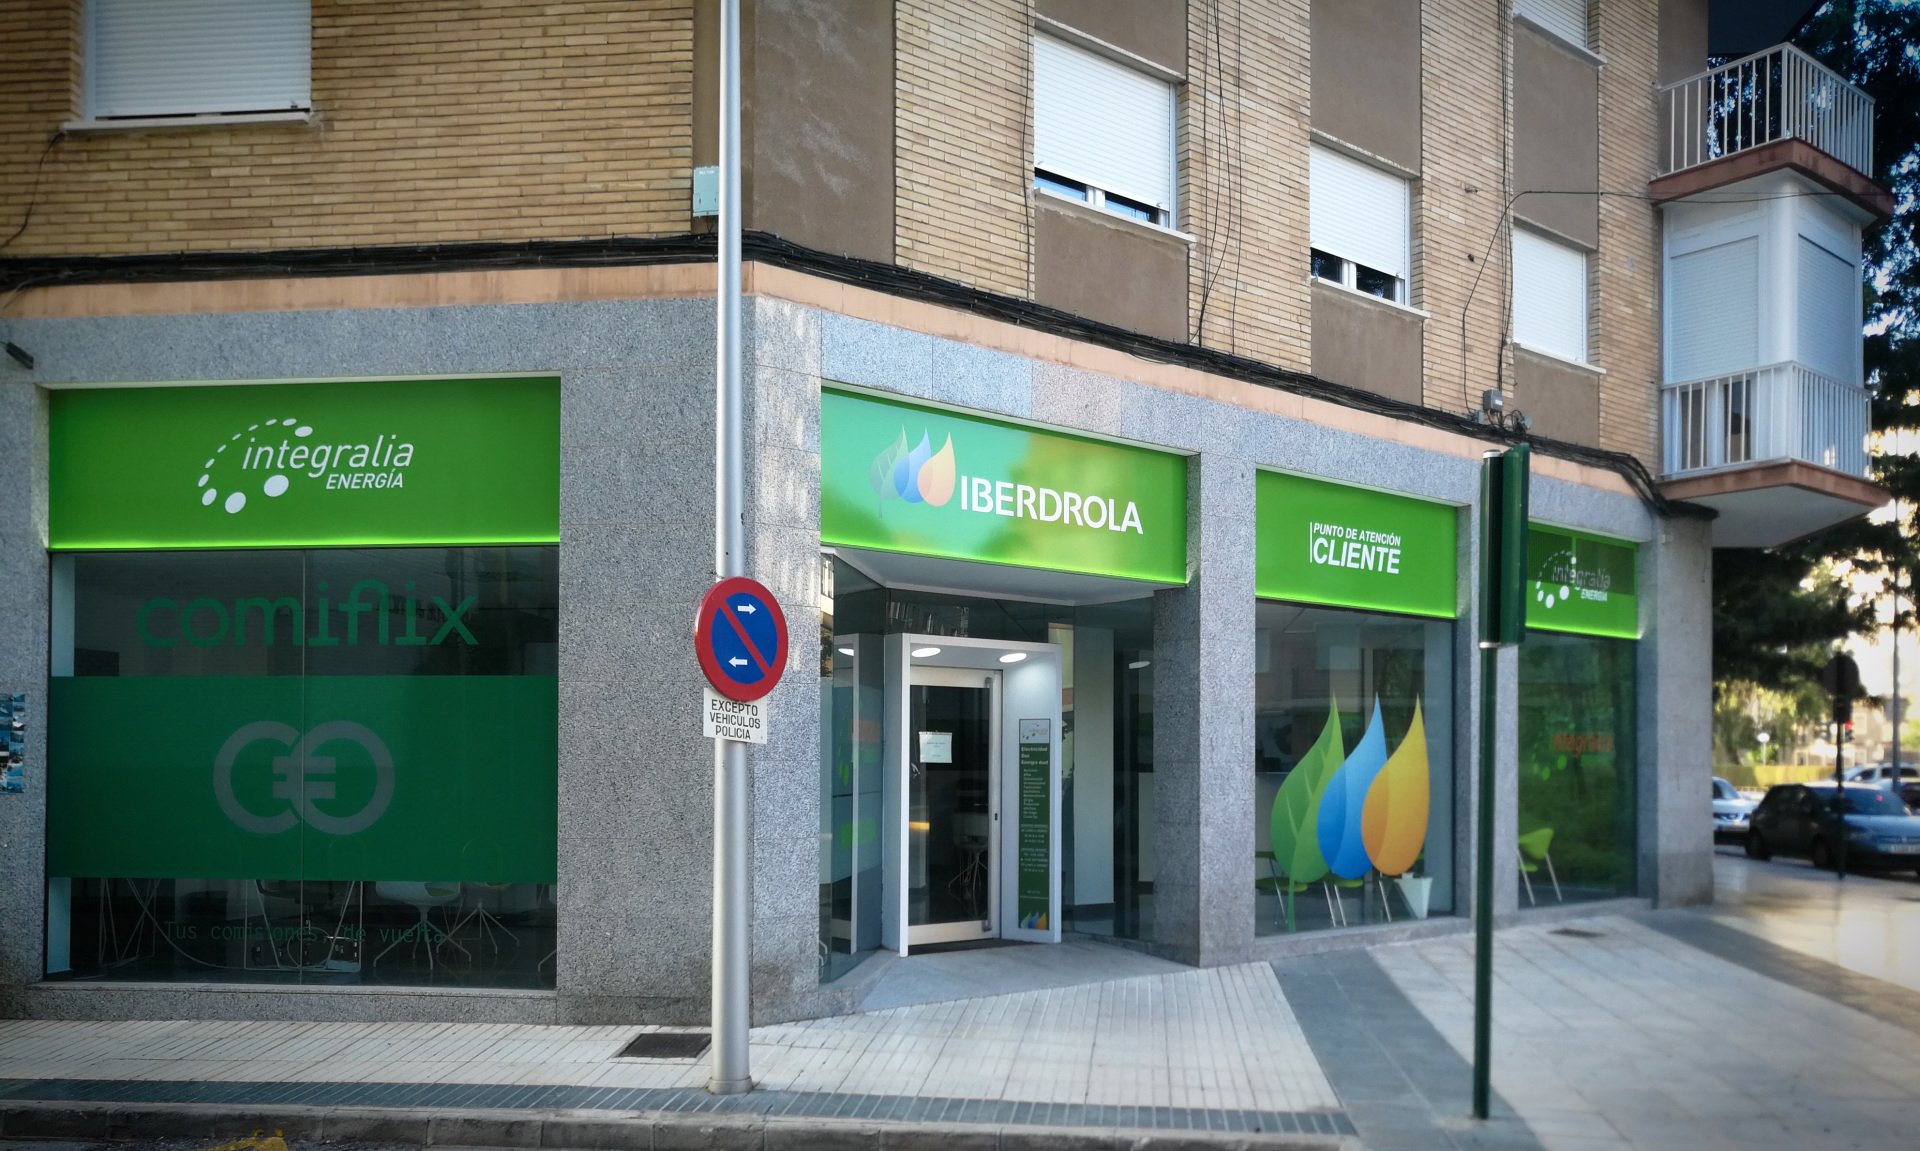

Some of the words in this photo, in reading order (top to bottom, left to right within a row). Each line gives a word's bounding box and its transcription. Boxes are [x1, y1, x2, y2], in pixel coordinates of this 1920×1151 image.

[242, 434, 414, 478] integralia
[326, 468, 404, 489] ENERGÍA
[960, 475, 1144, 535] IBERDROLA
[1313, 522, 1344, 538] PUNTO
[1345, 528, 1358, 540] DE
[1359, 530, 1401, 547] ATENCIÓN
[1313, 537, 1401, 575] CLIENTE
[1552, 559, 1611, 592] integralia
[135, 578, 480, 649] comiflix
[711, 699, 758, 716] EXCEPTO
[709, 712, 760, 729] VEHICULOS
[715, 725, 751, 739] POLICIA
[164, 921, 198, 940] Tus
[343, 923, 366, 943] de
[380, 923, 446, 943] vuelta
